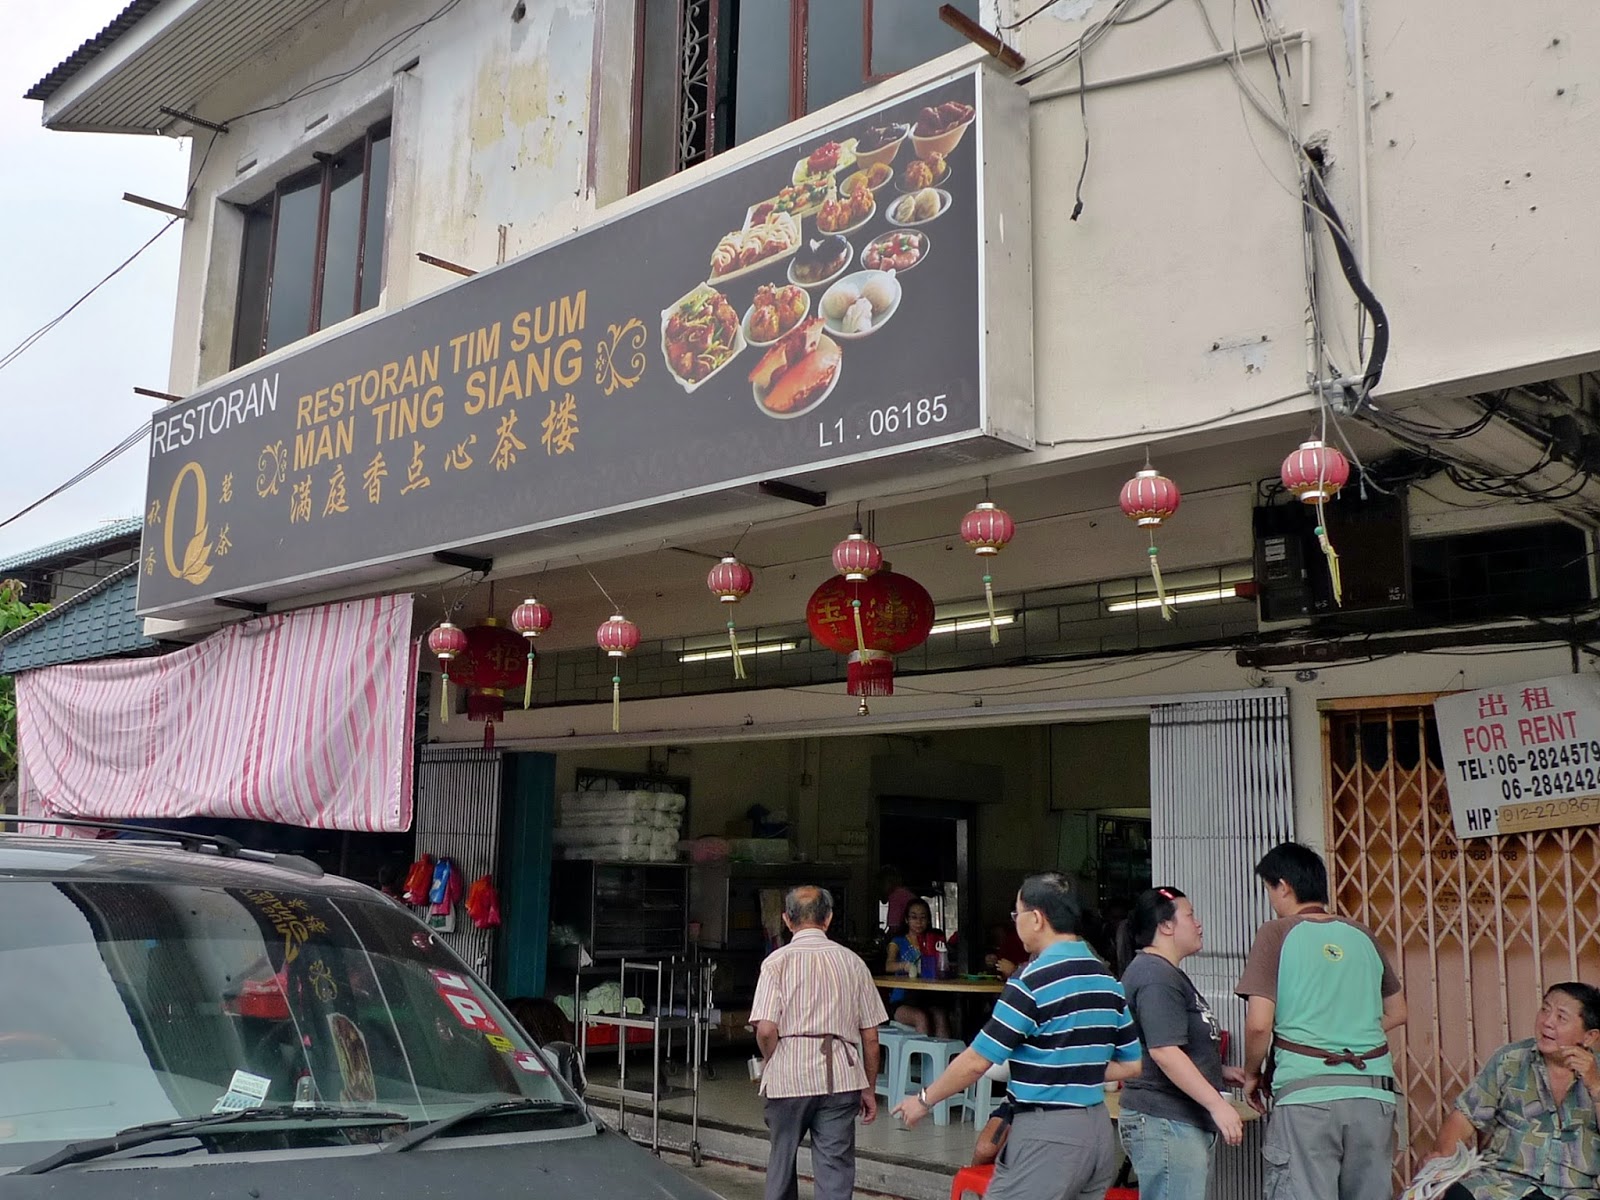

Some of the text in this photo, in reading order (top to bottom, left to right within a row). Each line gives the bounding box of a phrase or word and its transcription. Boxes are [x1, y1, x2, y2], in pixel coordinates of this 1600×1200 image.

[296, 289, 587, 430] RESTORAN TIM SUM
[152, 373, 279, 457] RESTORAN
[293, 338, 582, 471] MAN TING SIANG
[870, 394, 947, 436] 06185
[1478, 686, 1555, 720] 出租
[1463, 710, 1577, 755] FOR RENT
[1501, 766, 1600, 800] 06-284242
[444, 993, 487, 1026] P
